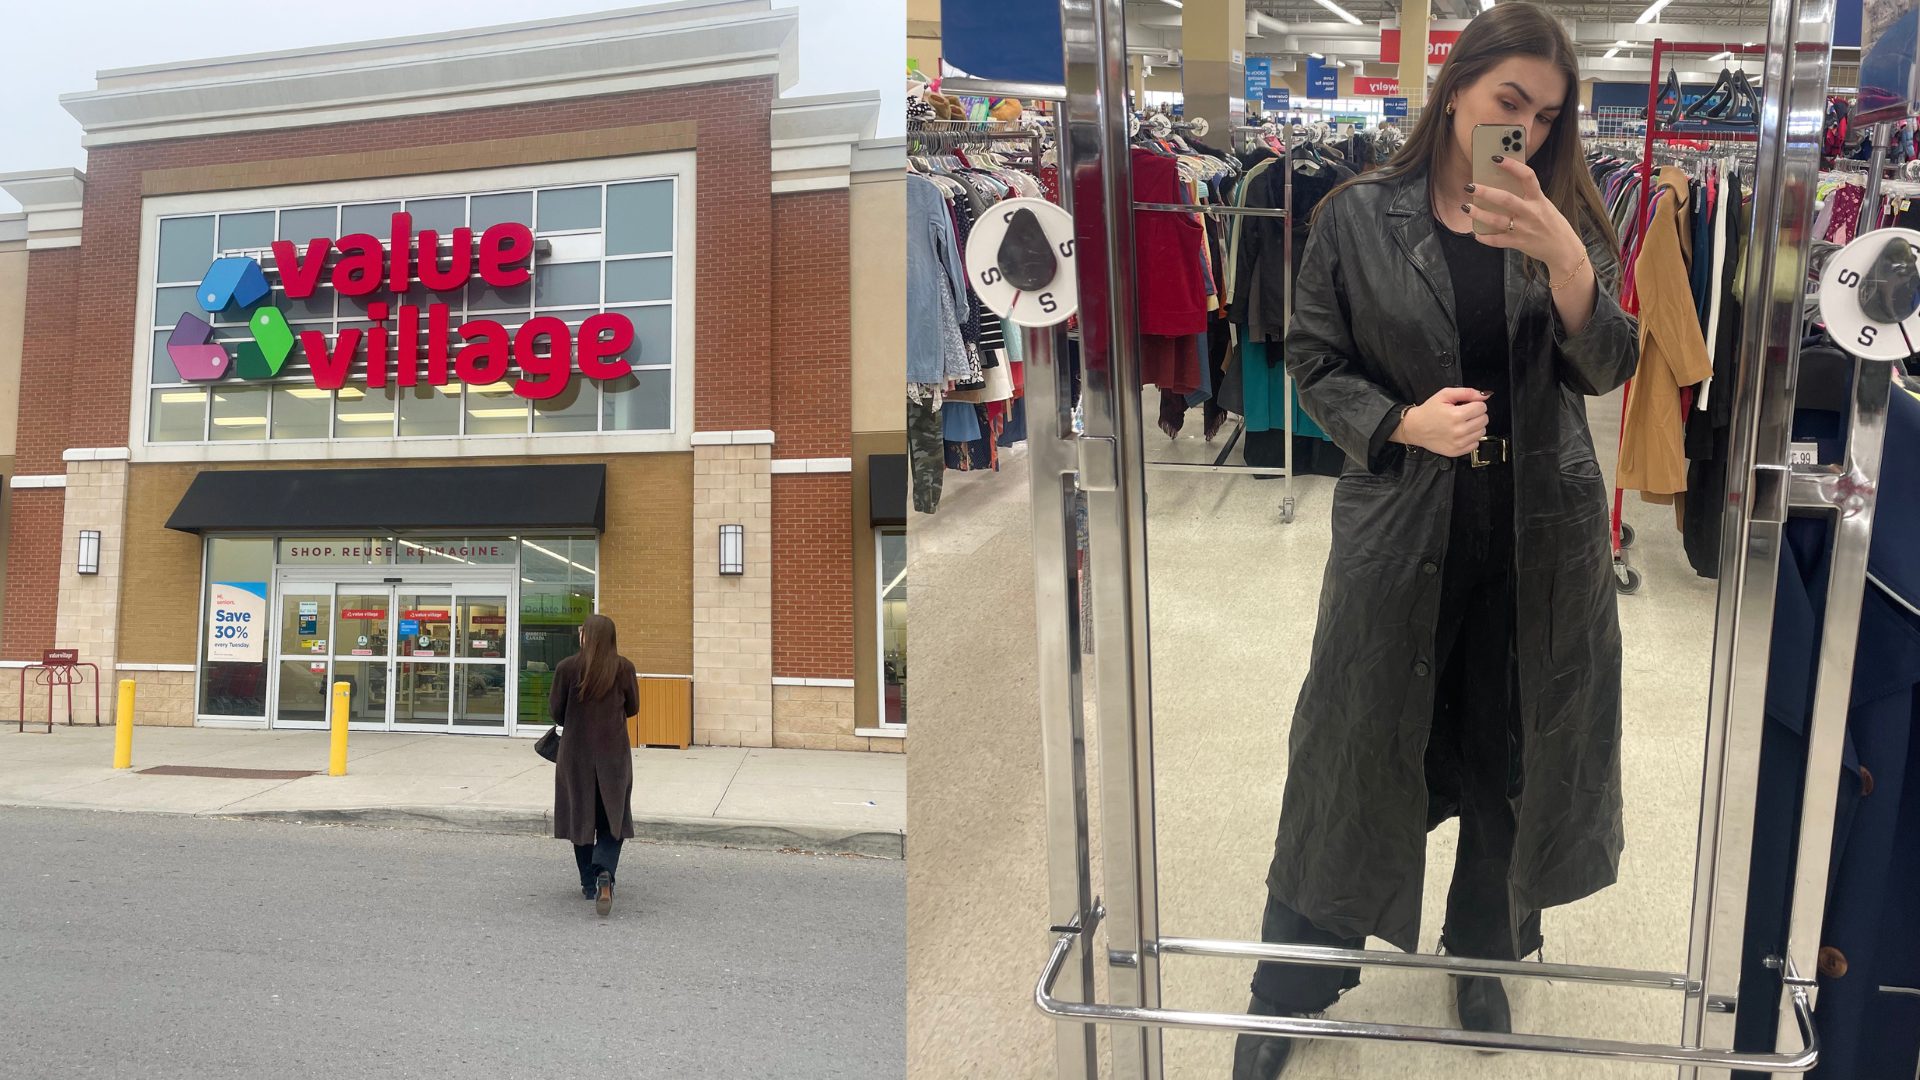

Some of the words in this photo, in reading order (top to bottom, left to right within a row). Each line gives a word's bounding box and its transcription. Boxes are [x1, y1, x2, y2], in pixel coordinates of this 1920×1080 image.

[271, 211, 534, 299] value
[1060, 239, 1075, 258] S
[981, 267, 1002, 286] S
[1837, 268, 1860, 288] S
[1038, 292, 1057, 313] S
[1857, 325, 1878, 347] S
[301, 302, 635, 400] village
[291, 547, 335, 557] SHOP.
[342, 547, 400, 557] REUSE.
[406, 546, 505, 557] REIMAGINE.
[216, 609, 251, 622] Save
[525, 605, 559, 613] Donate
[215, 625, 249, 639] 30%
